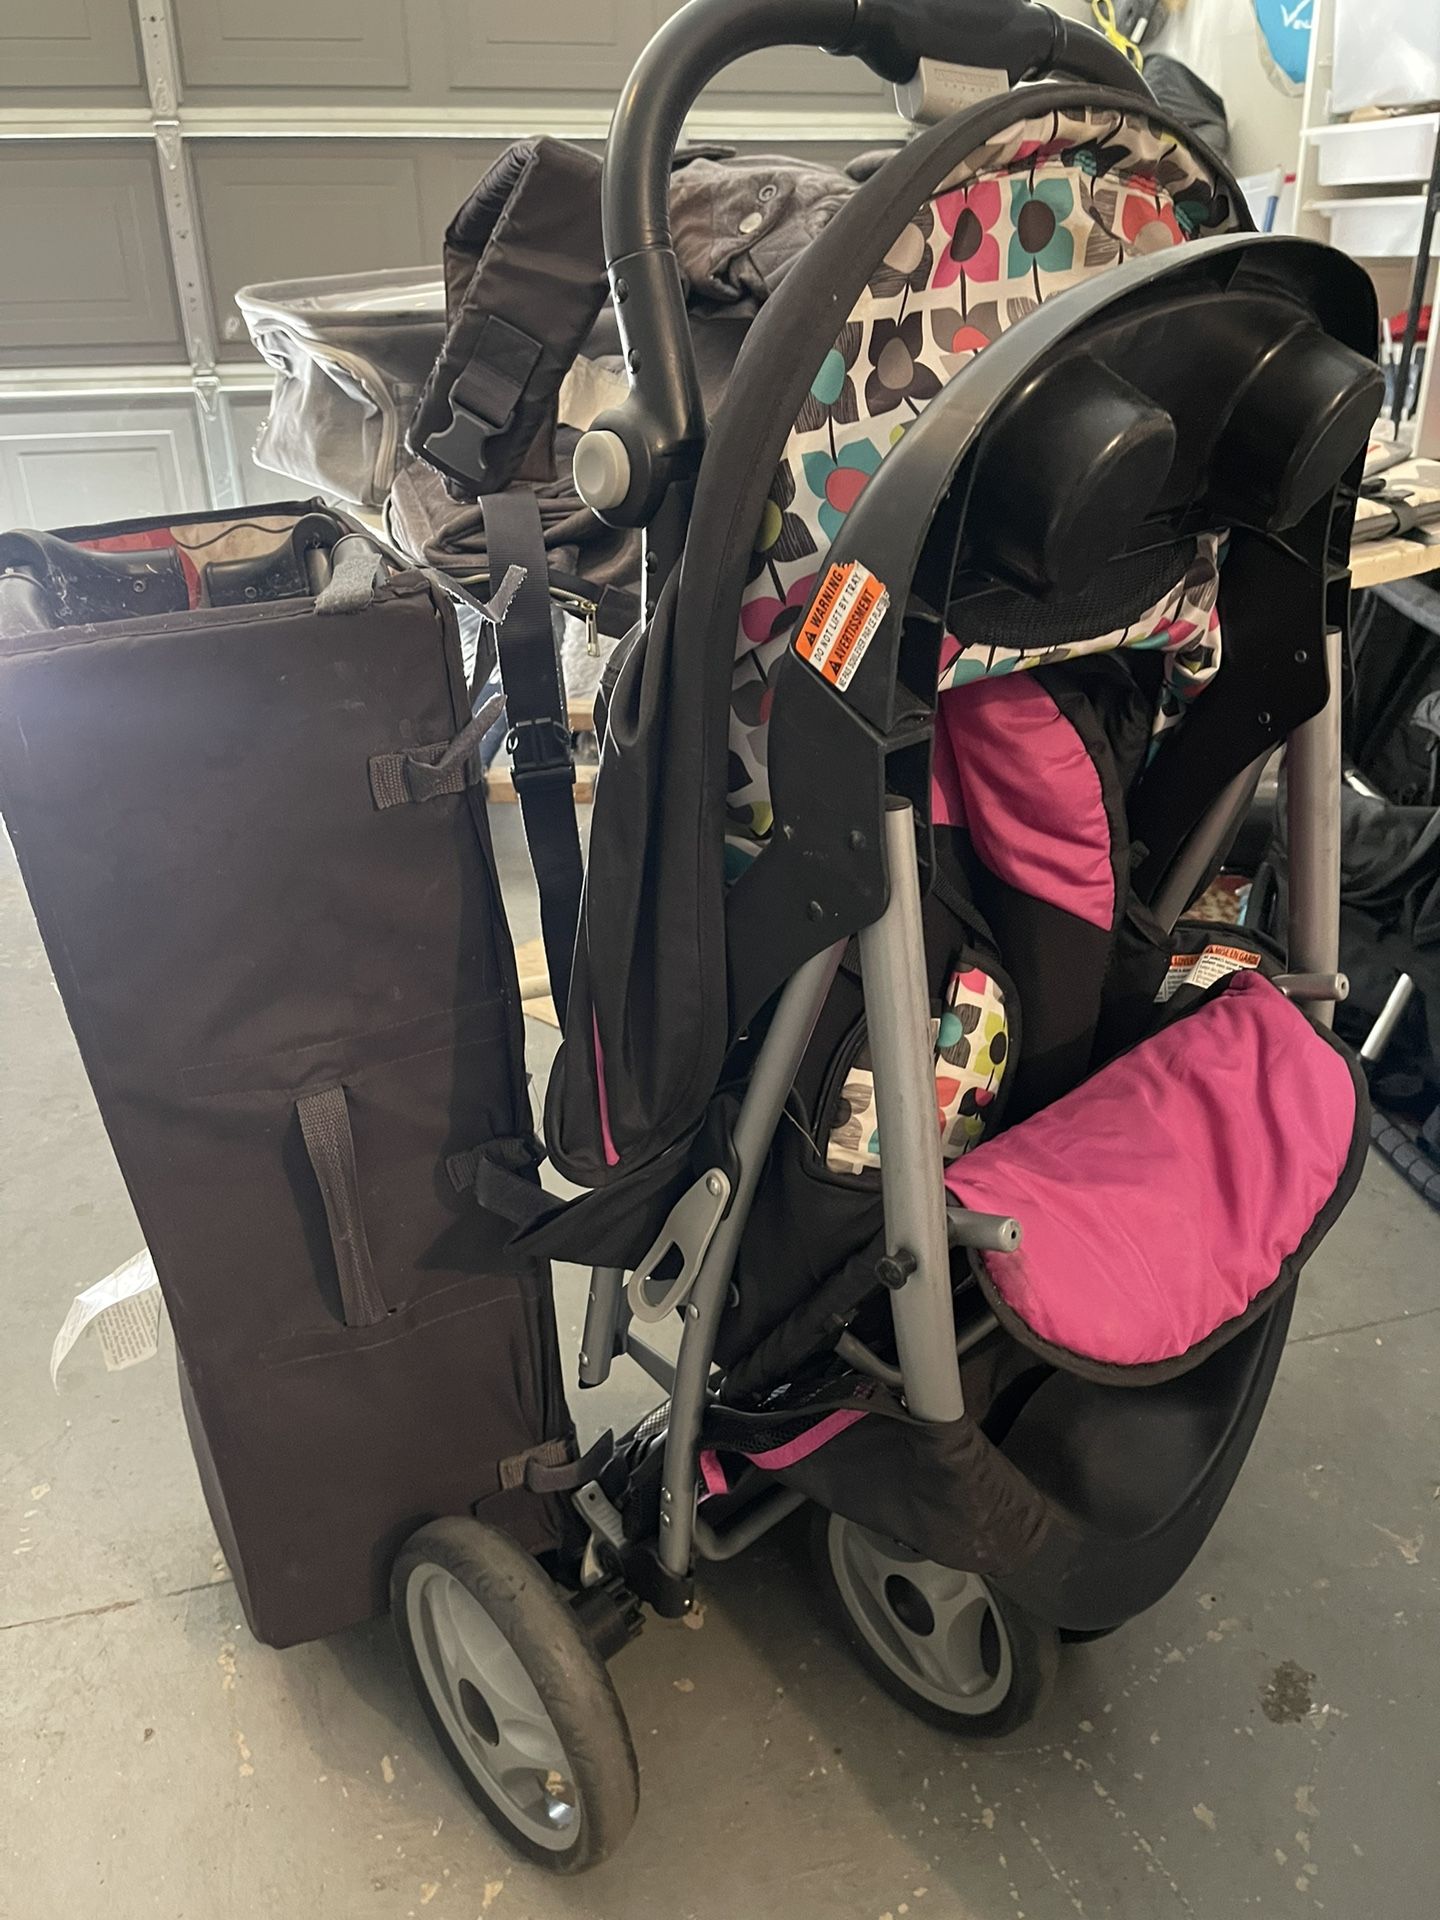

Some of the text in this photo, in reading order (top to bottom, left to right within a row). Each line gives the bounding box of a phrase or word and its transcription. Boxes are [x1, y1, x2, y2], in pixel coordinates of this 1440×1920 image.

[811, 570, 843, 628] WARNING
[814, 571, 861, 662] DO NOT LIFT BY TRAY
